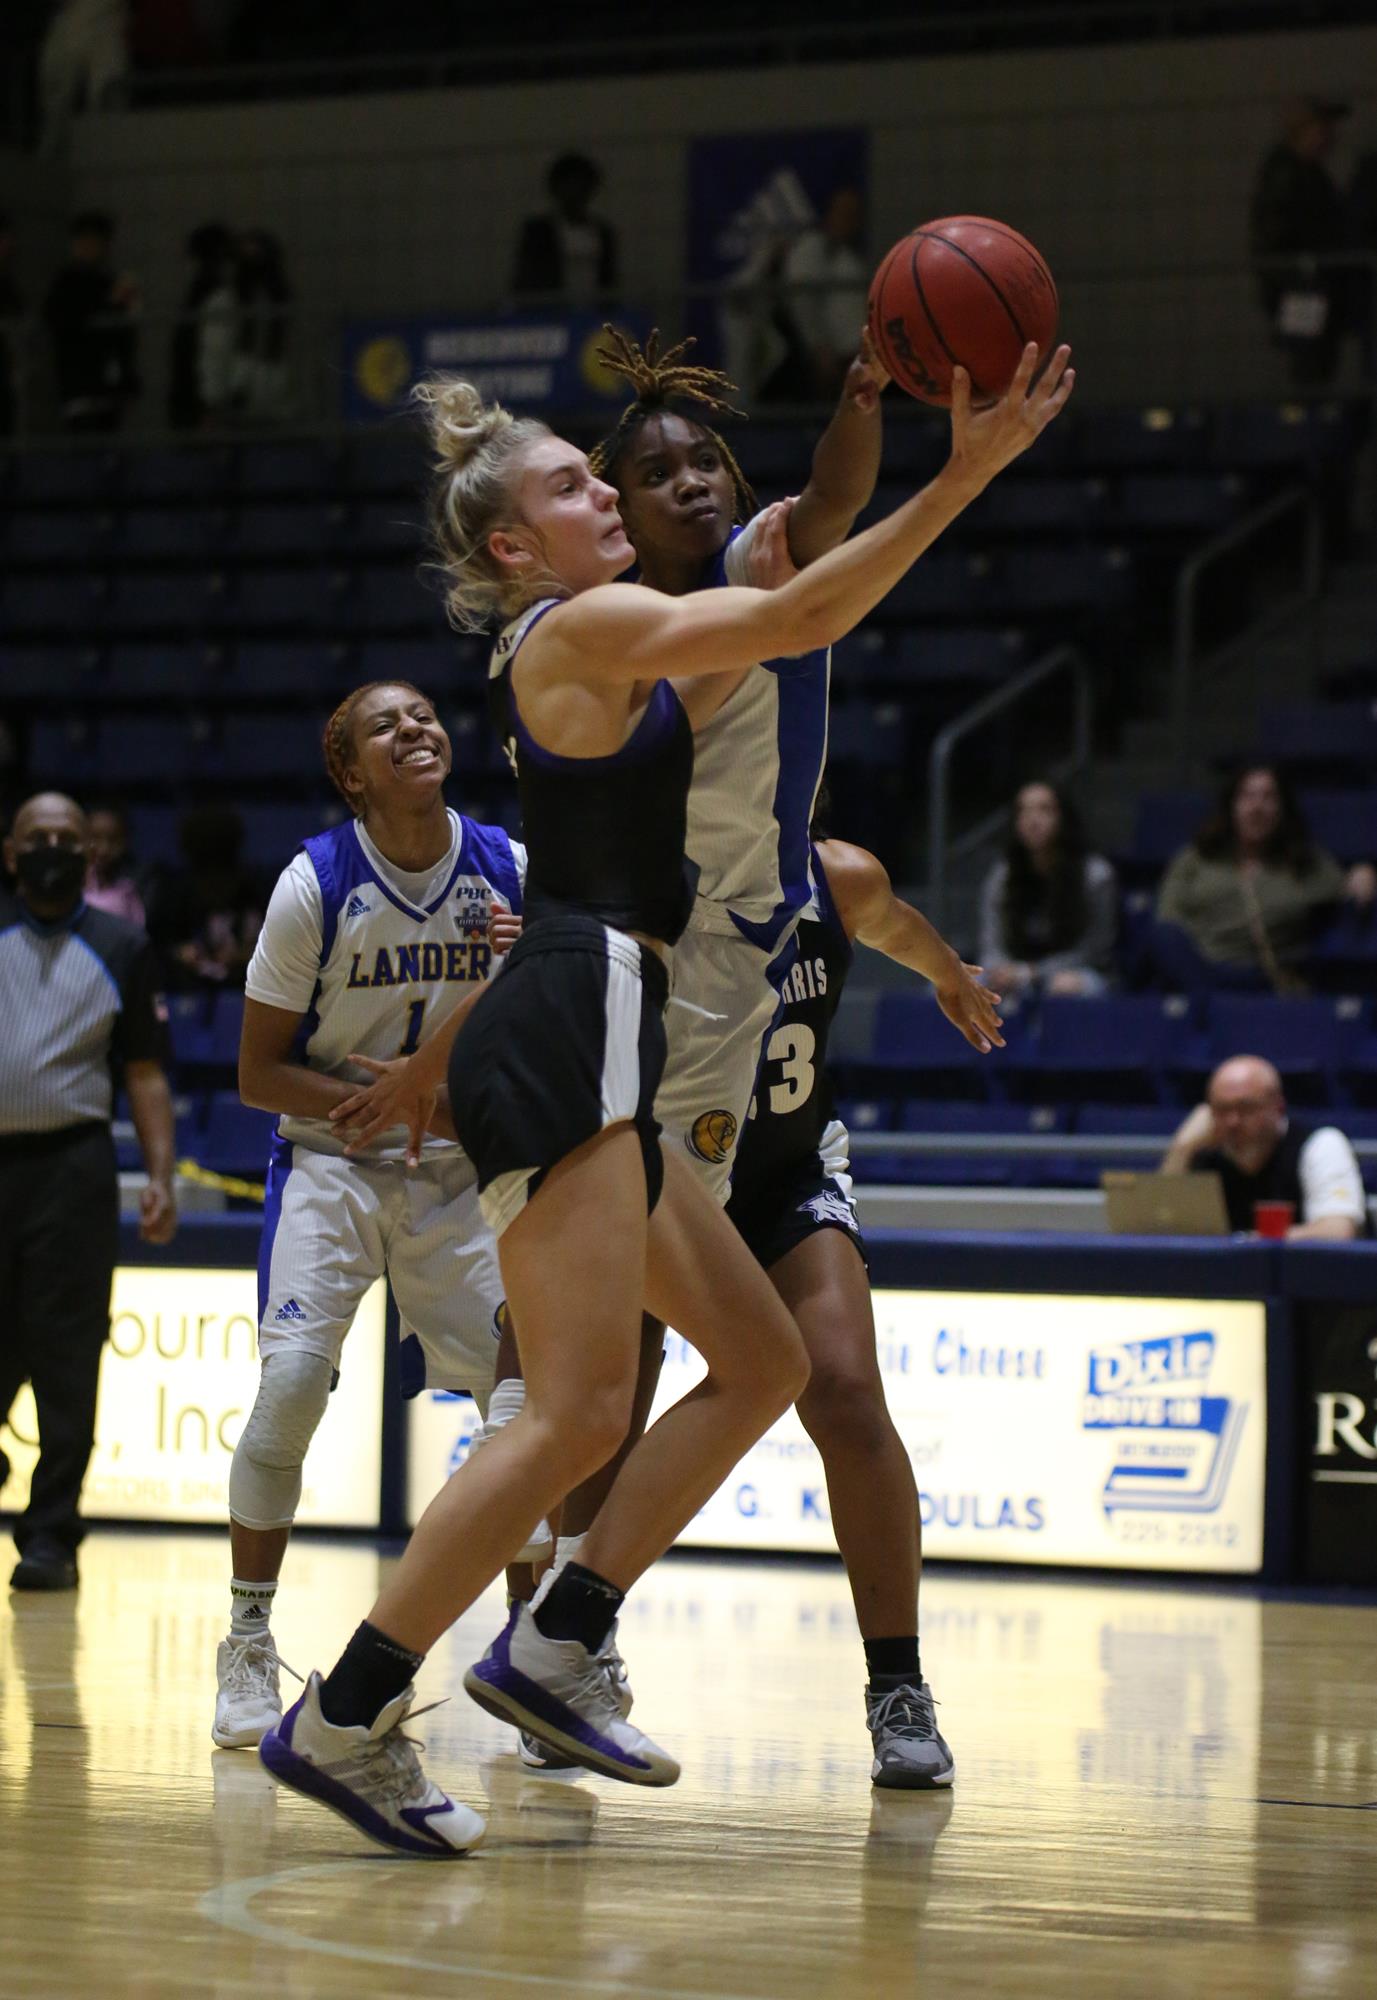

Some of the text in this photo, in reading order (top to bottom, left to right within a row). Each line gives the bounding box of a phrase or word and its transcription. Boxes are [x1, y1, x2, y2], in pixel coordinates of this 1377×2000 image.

[456, 887, 492, 900] PBC
[347, 943, 492, 988] LANDER
[400, 997, 427, 1055] 1
[748, 1023, 816, 1120] 3
[275, 1311, 307, 1321] adidas
